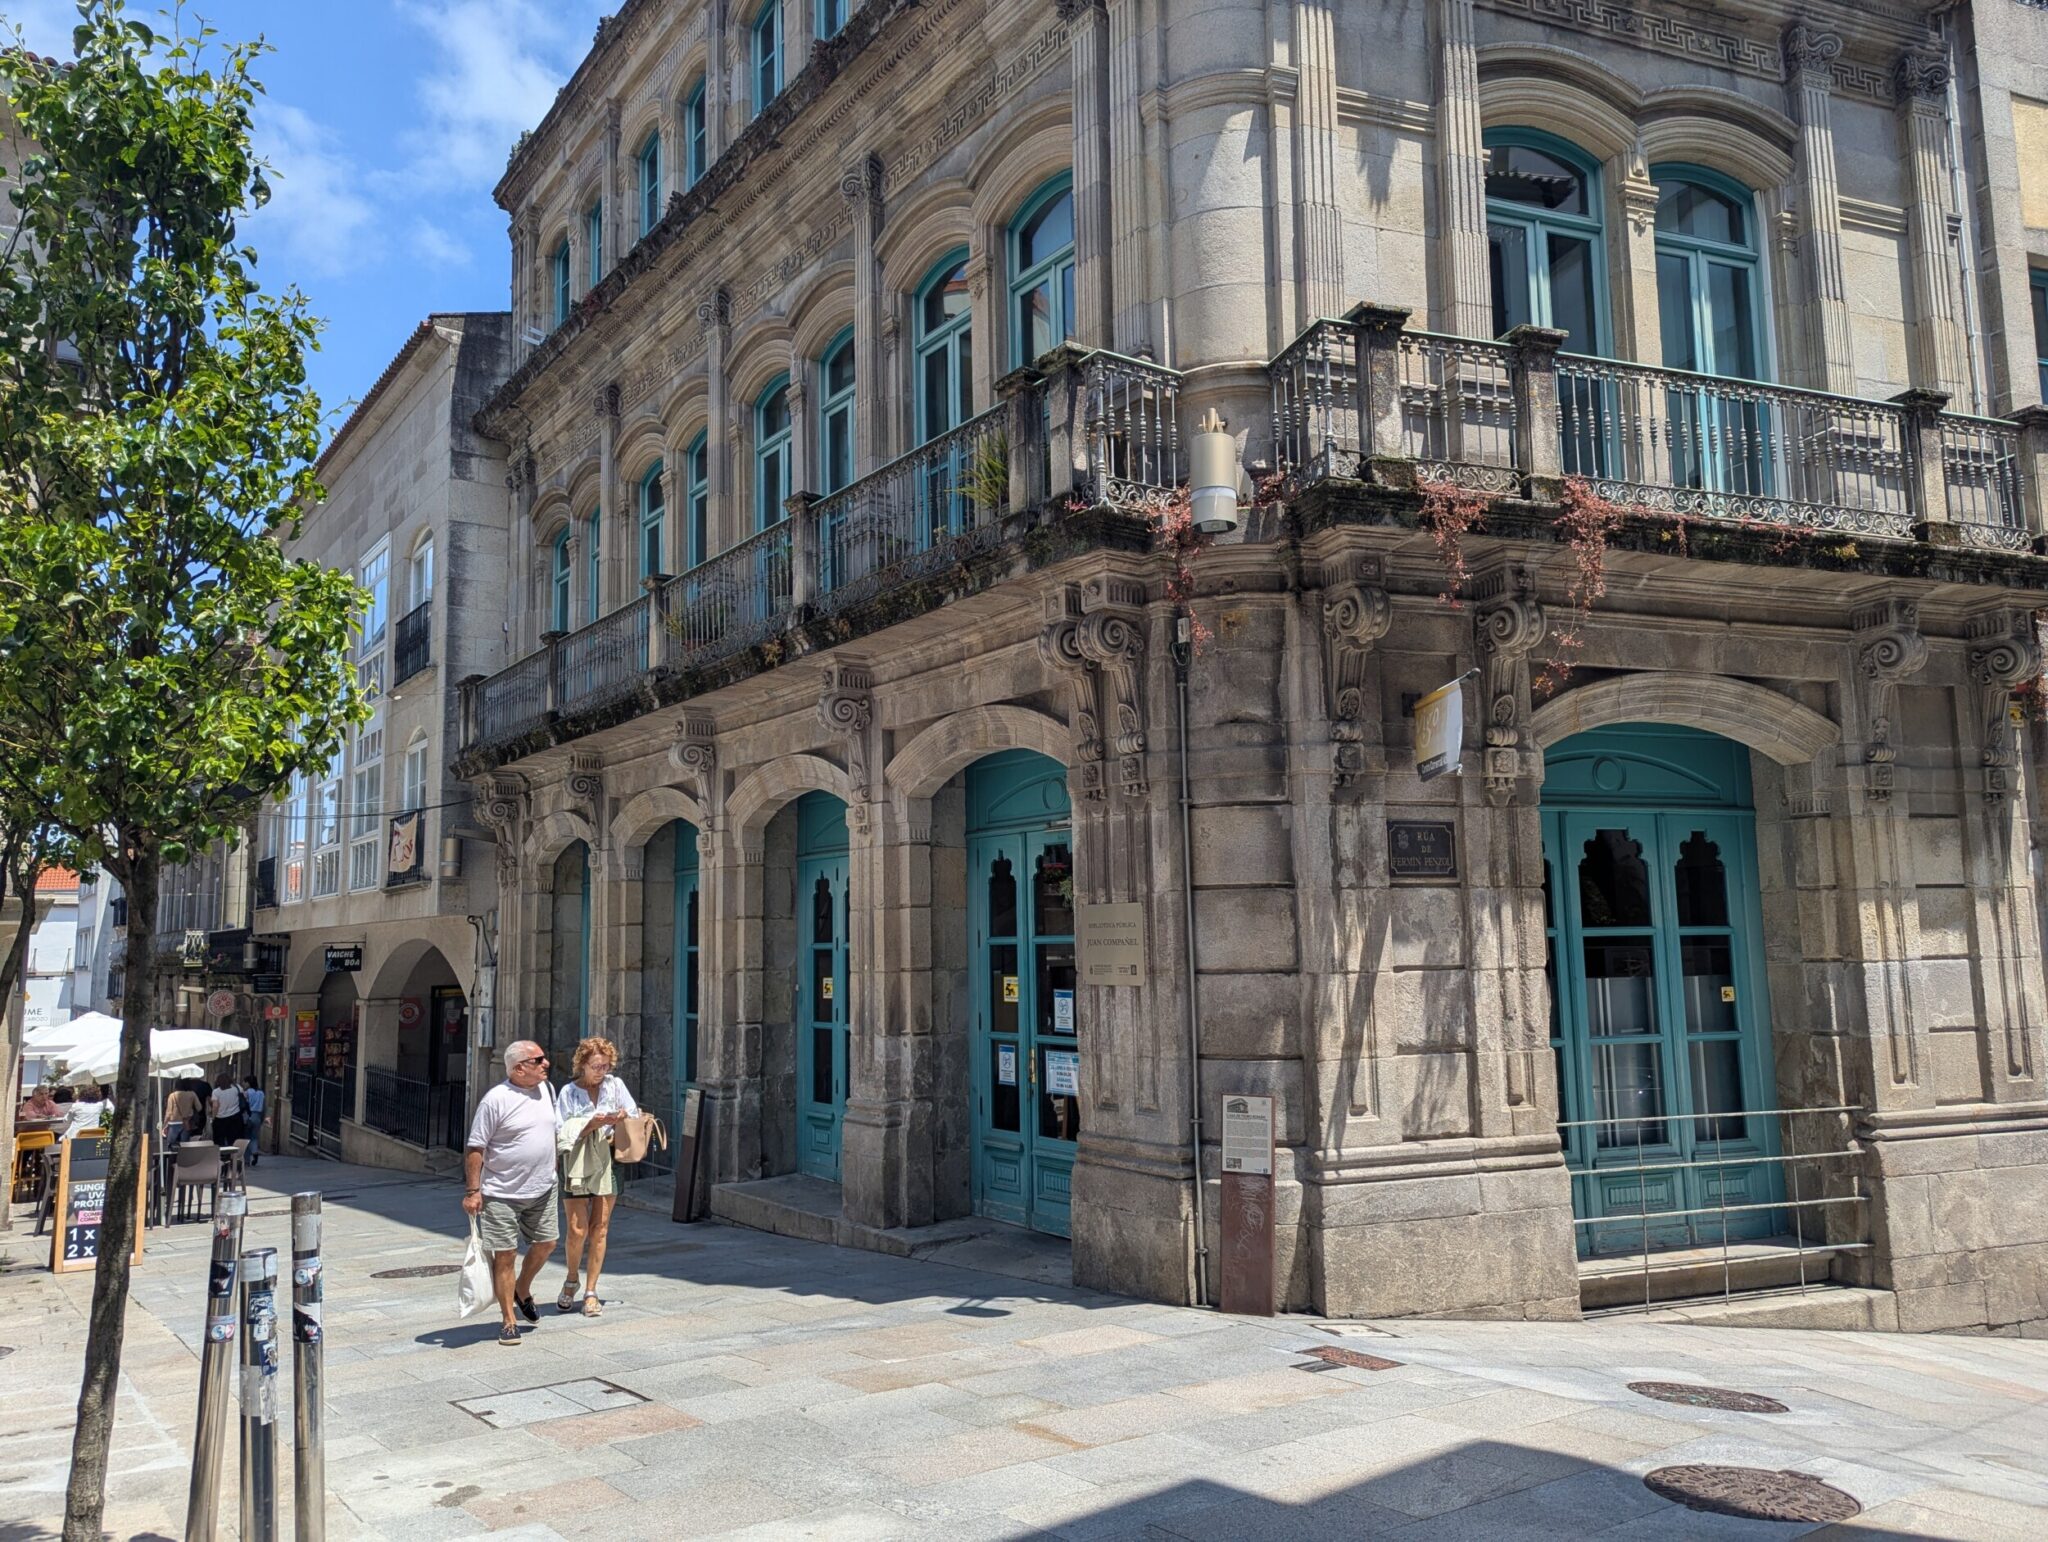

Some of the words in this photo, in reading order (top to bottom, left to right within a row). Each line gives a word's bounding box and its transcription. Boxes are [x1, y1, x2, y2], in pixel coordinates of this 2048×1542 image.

[1421, 845, 1432, 853] DE
[1087, 939, 1102, 948] JUAN
[74, 1183, 105, 1192] SUNGL
[74, 1199, 104, 1208] PROTE
[70, 1228, 78, 1241] 1
[67, 1244, 79, 1258] 2
